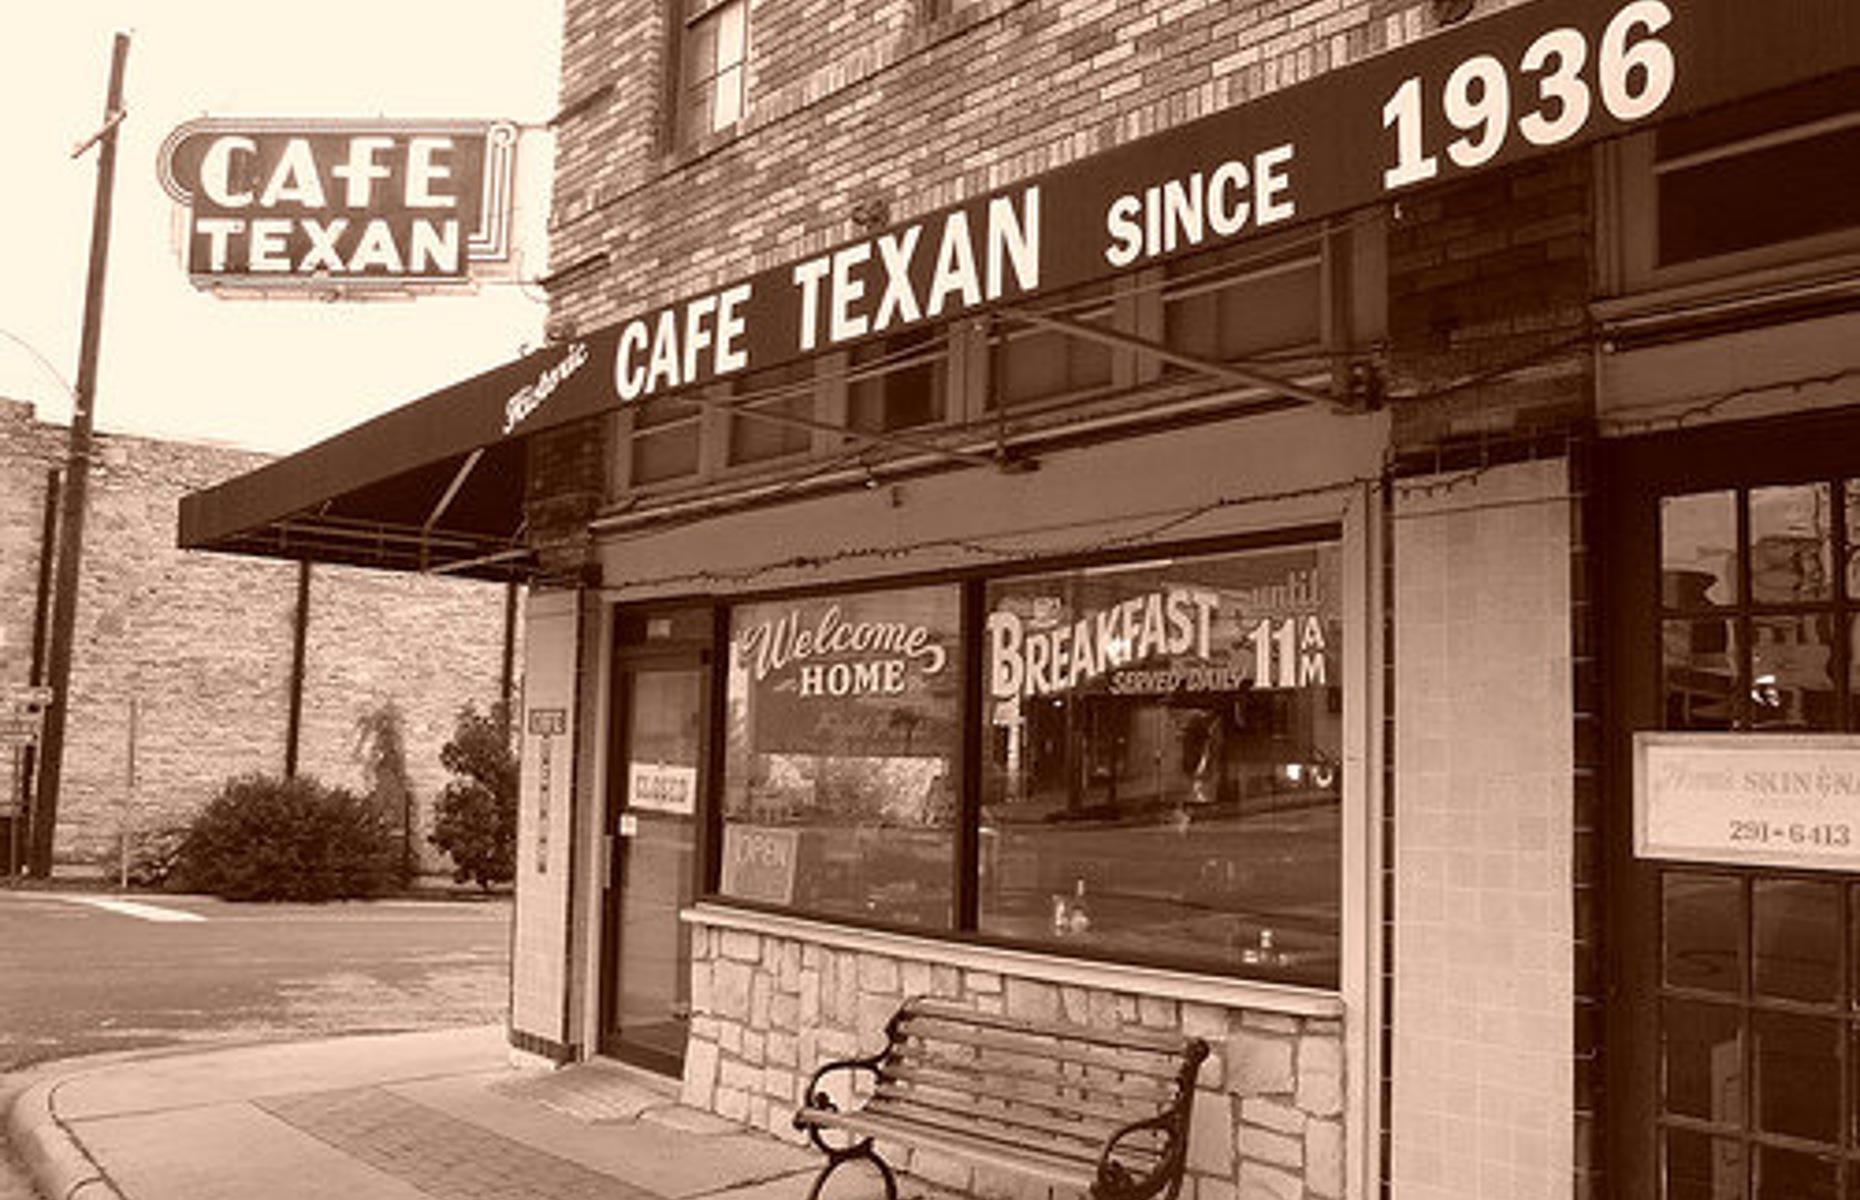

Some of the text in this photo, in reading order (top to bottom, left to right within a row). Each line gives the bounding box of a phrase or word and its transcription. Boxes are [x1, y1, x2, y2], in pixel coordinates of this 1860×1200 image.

[199, 134, 457, 210] CAFE
[614, 283, 753, 402] CAFE
[793, 185, 1041, 352] TEXAN
[1104, 142, 1296, 269] SINCE
[1382, 0, 1677, 190] 1936
[195, 217, 460, 273] TEXAN
[742, 604, 946, 682] Welcome
[800, 660, 906, 697] HOME
[1248, 617, 1297, 688] 11
[1108, 668, 1181, 695] SERVED
